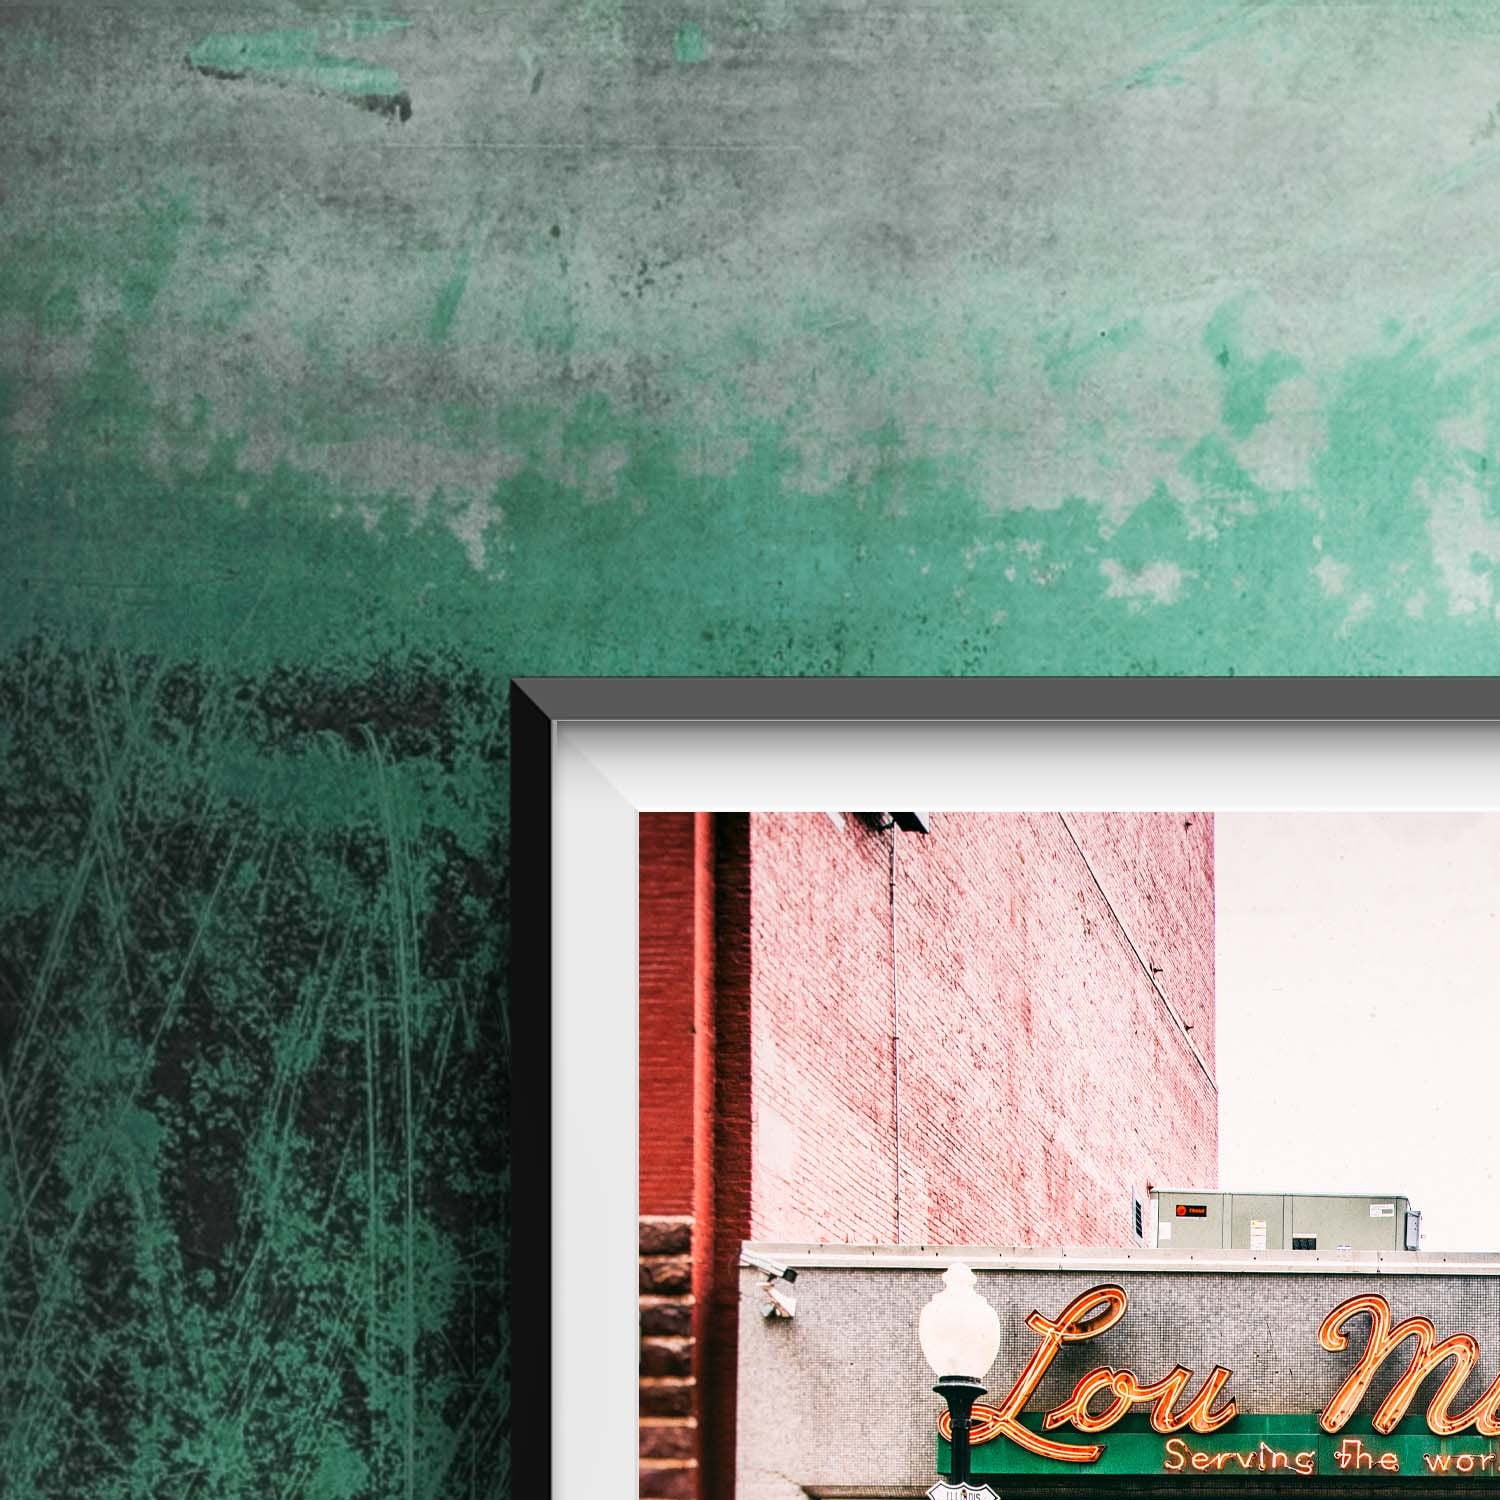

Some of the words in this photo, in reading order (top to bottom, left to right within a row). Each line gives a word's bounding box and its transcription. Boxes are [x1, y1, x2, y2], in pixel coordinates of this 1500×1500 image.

[937, 1284, 1238, 1463] Lou
[1164, 1438, 1316, 1475] Serving
[1334, 1438, 1400, 1472] the
